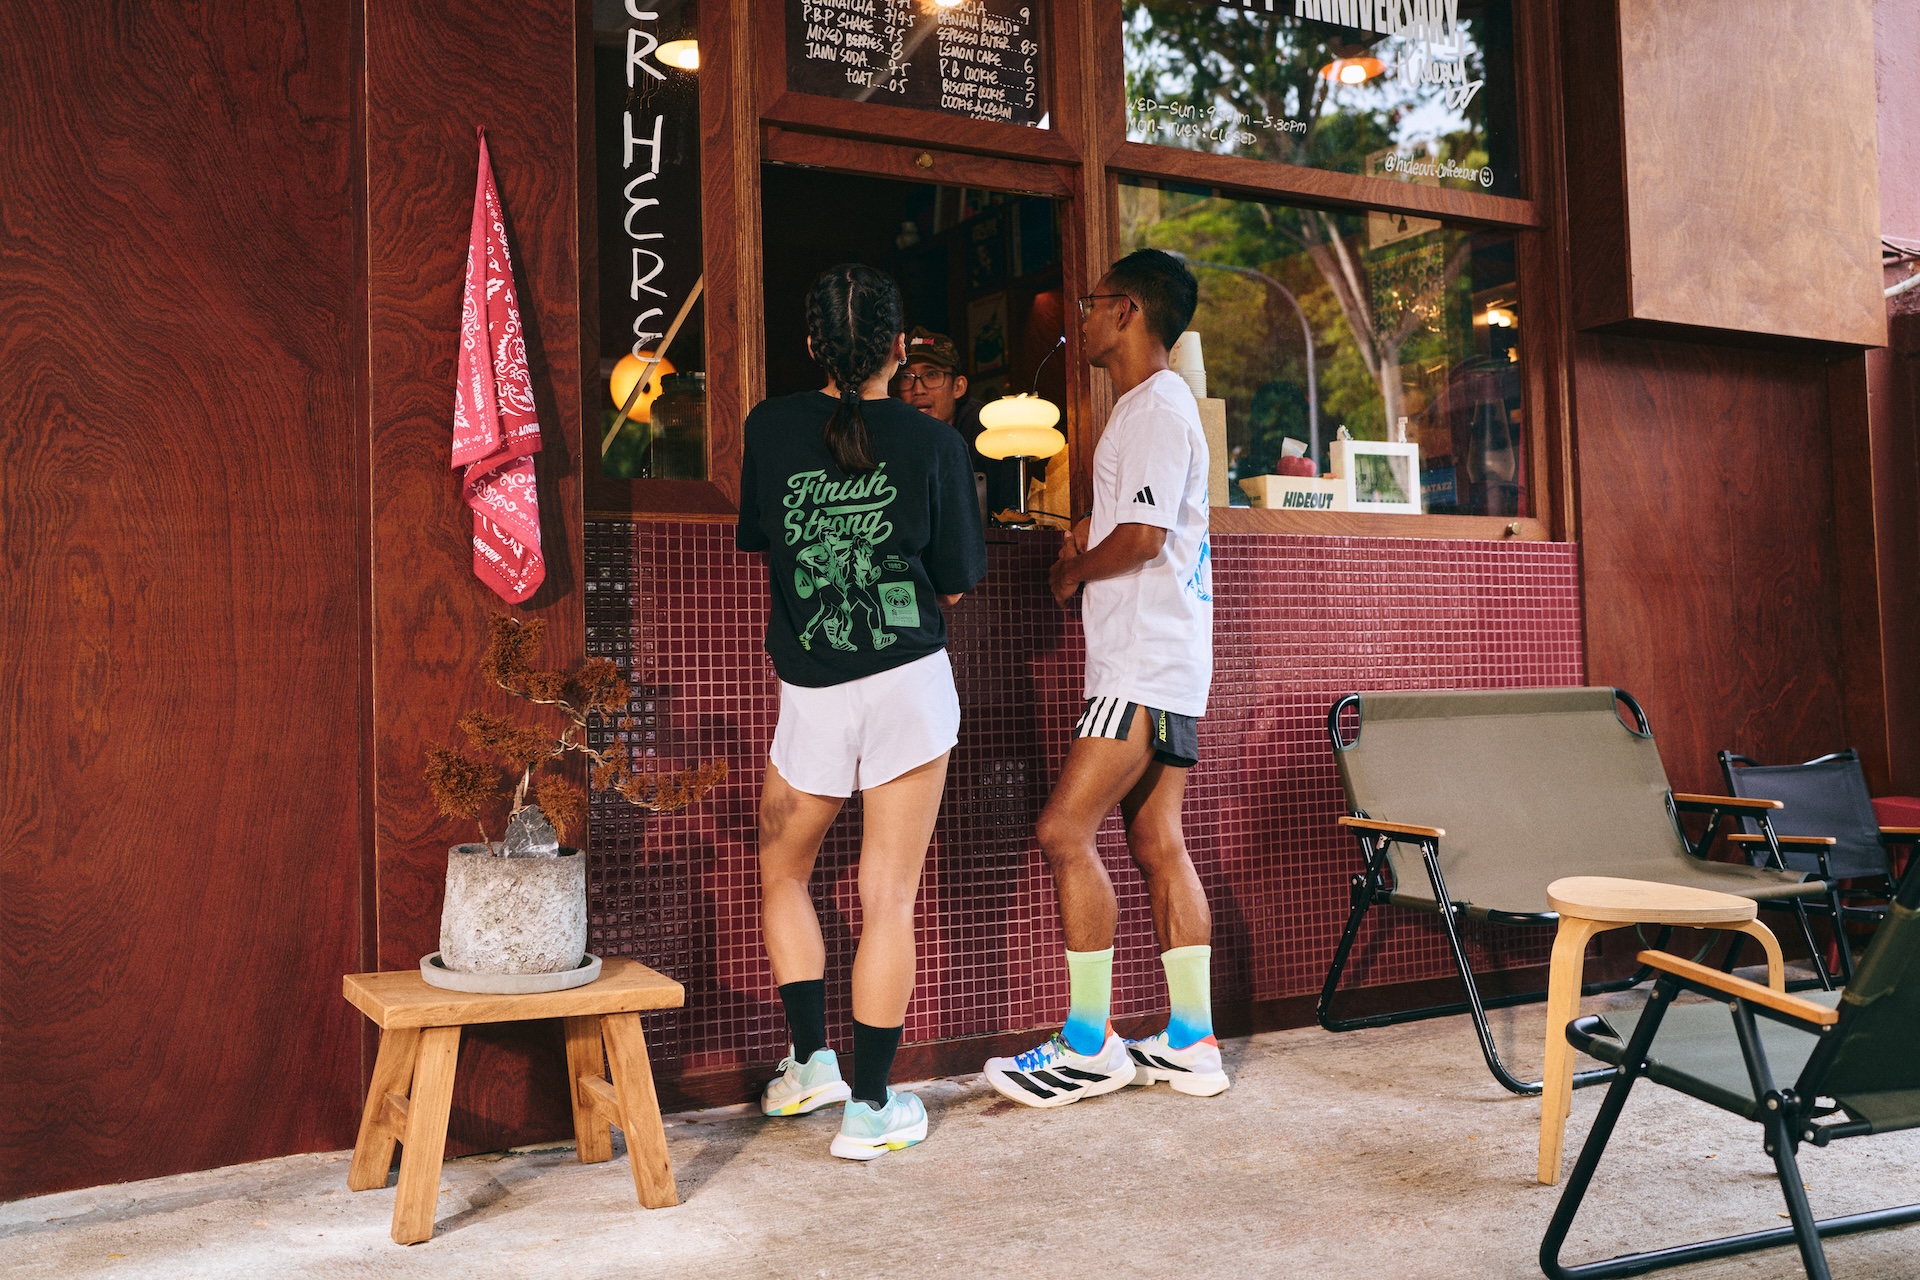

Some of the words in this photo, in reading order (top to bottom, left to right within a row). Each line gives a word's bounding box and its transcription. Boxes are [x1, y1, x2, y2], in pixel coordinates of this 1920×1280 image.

[837, 12, 874, 34] SHAKE
[937, 9, 979, 31] BANANA
[981, 18, 1012, 36] BREAD
[1019, 7, 1030, 25] 9
[1292, 0, 1459, 47] VERSARY
[806, 23, 843, 45] MIXED
[845, 33, 885, 52] BERRIES
[890, 42, 904, 60] 8
[839, 48, 868, 67] SODA
[939, 42, 974, 62] LEMON
[977, 50, 1002, 67] CAKE
[1024, 58, 1034, 74] 6
[964, 65, 999, 85] COOKIE
[1025, 77, 1035, 92] 5
[941, 94, 973, 111] COOKIE
[983, 102, 1012, 120] CREAM
[942, 78, 978, 98] BISCOFF
[978, 85, 1006, 102] COOKIE
[1024, 93, 1035, 109] 5
[1209, 127, 1257, 145] CLOSED
[622, 110, 668, 364] HERE
[782, 461, 898, 516] Finish
[1282, 491, 1334, 509] HIDEOUT
[784, 508, 894, 548] Strong
